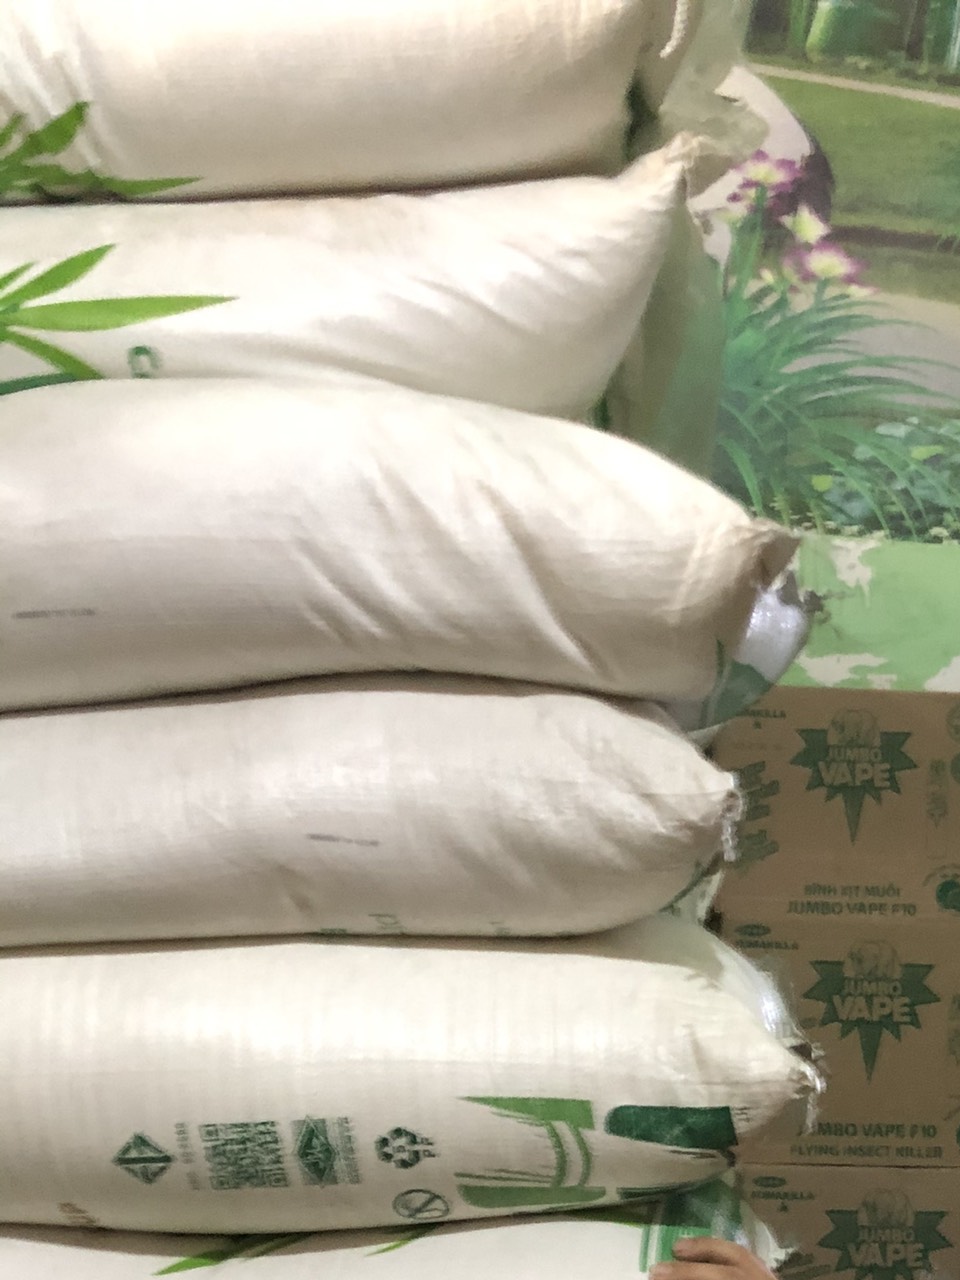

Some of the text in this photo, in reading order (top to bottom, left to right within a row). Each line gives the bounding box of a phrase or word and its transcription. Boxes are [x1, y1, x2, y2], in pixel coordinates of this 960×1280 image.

[819, 761, 891, 787] VAPE
[787, 901, 843, 915] JUMBO
[847, 902, 888, 915] VAPE
[832, 995, 911, 1021] VAPE
[862, 1123, 905, 1137] VAPE
[843, 1145, 890, 1158] INSECT
[896, 1146, 943, 1159] KILLER
[847, 1243, 924, 1268] VAPE
